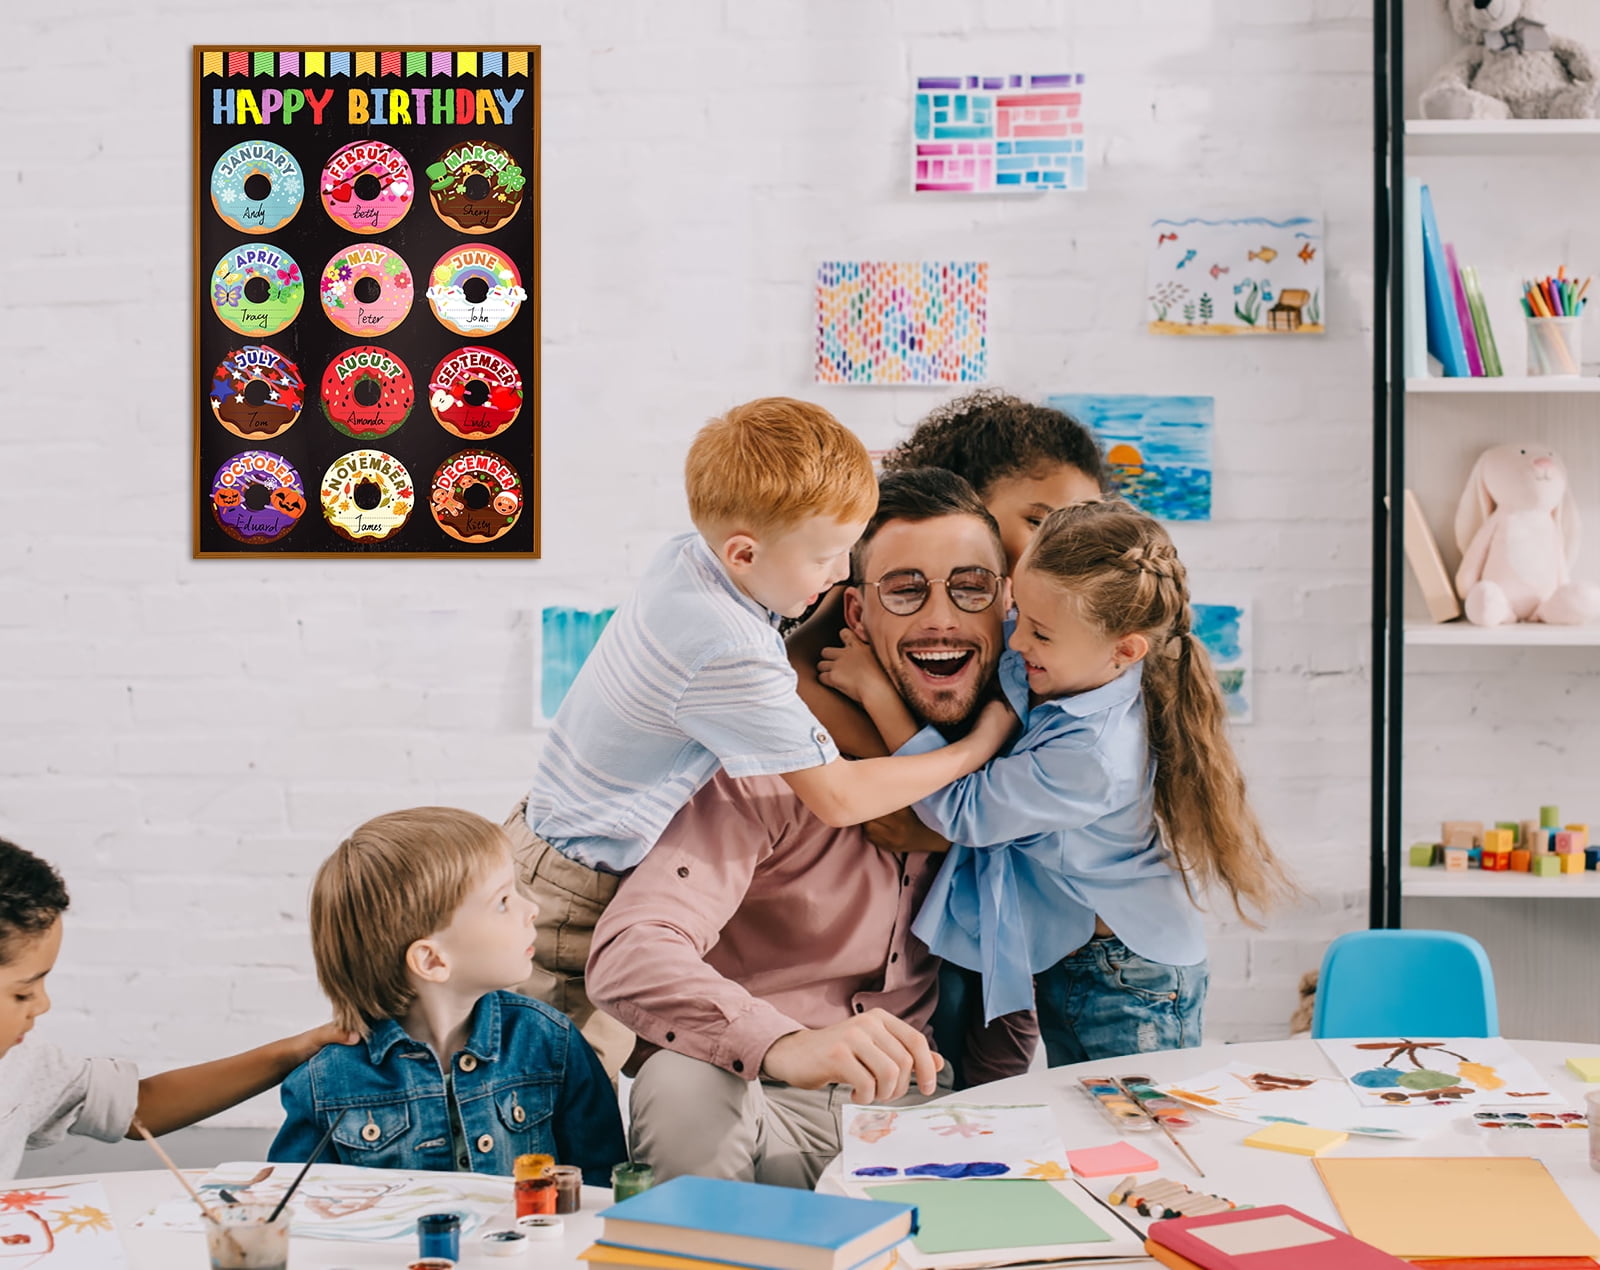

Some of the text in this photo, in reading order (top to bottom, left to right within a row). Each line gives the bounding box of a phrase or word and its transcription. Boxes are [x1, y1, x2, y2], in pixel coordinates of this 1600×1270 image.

[212, 88, 525, 125] HAPPY BIRTHDAY
[219, 145, 297, 177] JANUARY
[329, 146, 408, 180] FEBRUARY
[445, 145, 510, 172] MARCH
[242, 203, 266, 225] Andy
[353, 204, 379, 227] Betty
[235, 250, 281, 269] APRIL
[345, 250, 386, 267] MAY
[452, 251, 499, 270] JUNE
[241, 308, 268, 328] Tracy
[358, 307, 384, 325] Peter
[466, 307, 489, 324] John
[236, 350, 279, 368] JULY
[335, 352, 402, 380] AUGUST
[437, 353, 516, 388] SEPTEMBER
[248, 411, 268, 428] Tom
[347, 411, 385, 426] Amanda
[220, 455, 294, 488] OCTOBER
[328, 456, 407, 492] NOVEMBER
[438, 455, 515, 490] DECEMBER
[354, 514, 382, 533] James
